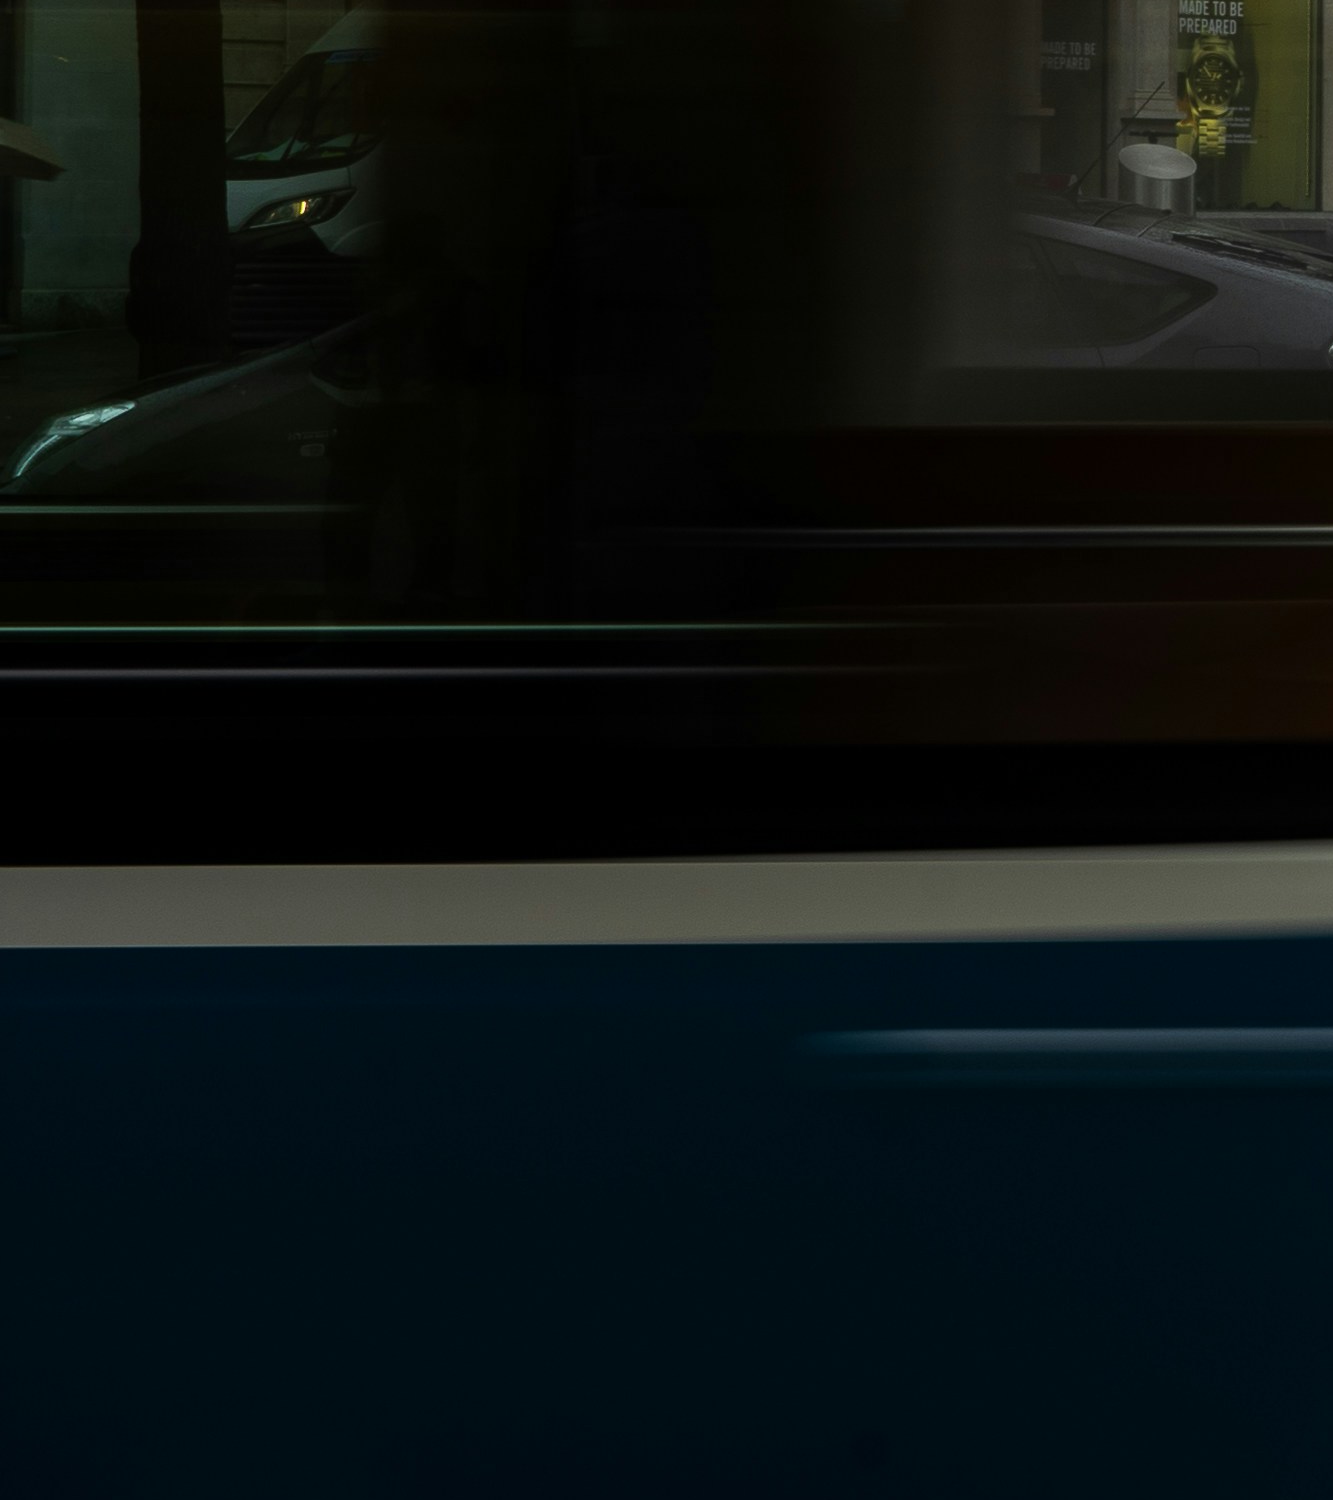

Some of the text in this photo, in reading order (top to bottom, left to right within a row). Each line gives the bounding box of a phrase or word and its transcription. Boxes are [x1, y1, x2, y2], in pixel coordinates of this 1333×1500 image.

[1179, 0, 1244, 17] MADE TO BE
[1179, 17, 1237, 35] PREPARED
[1069, 42, 1081, 55] TO
[1084, 42, 1096, 56] BE
